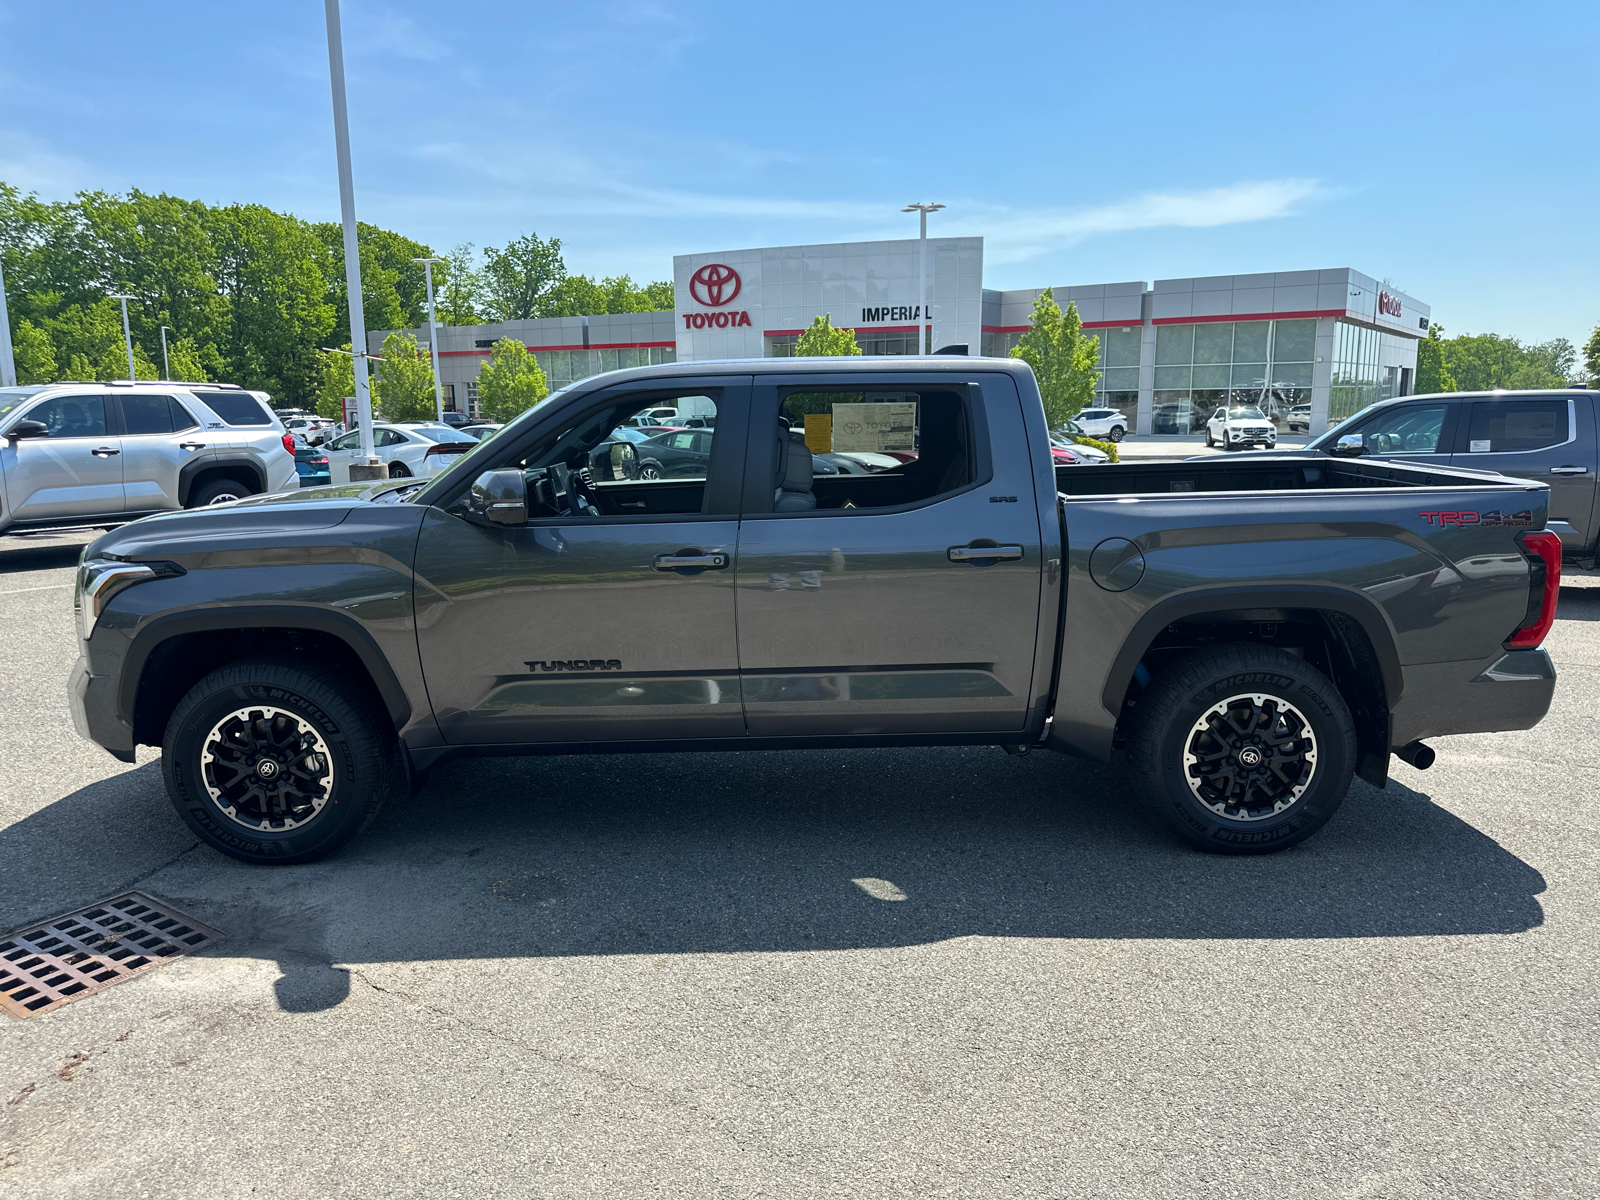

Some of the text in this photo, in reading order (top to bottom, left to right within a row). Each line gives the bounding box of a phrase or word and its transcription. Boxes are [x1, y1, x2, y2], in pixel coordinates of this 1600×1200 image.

[682, 311, 751, 329] TOYOTA
[862, 305, 932, 322] IMPERIAL
[1418, 510, 1532, 527] TRD 4x4
[524, 659, 622, 672] TUNDRA
[1215, 674, 1291, 692] MICHELIN
[269, 688, 337, 733] MICHELIN
[193, 810, 260, 852] MICHELIN
[1217, 825, 1291, 843] MICHELIN
